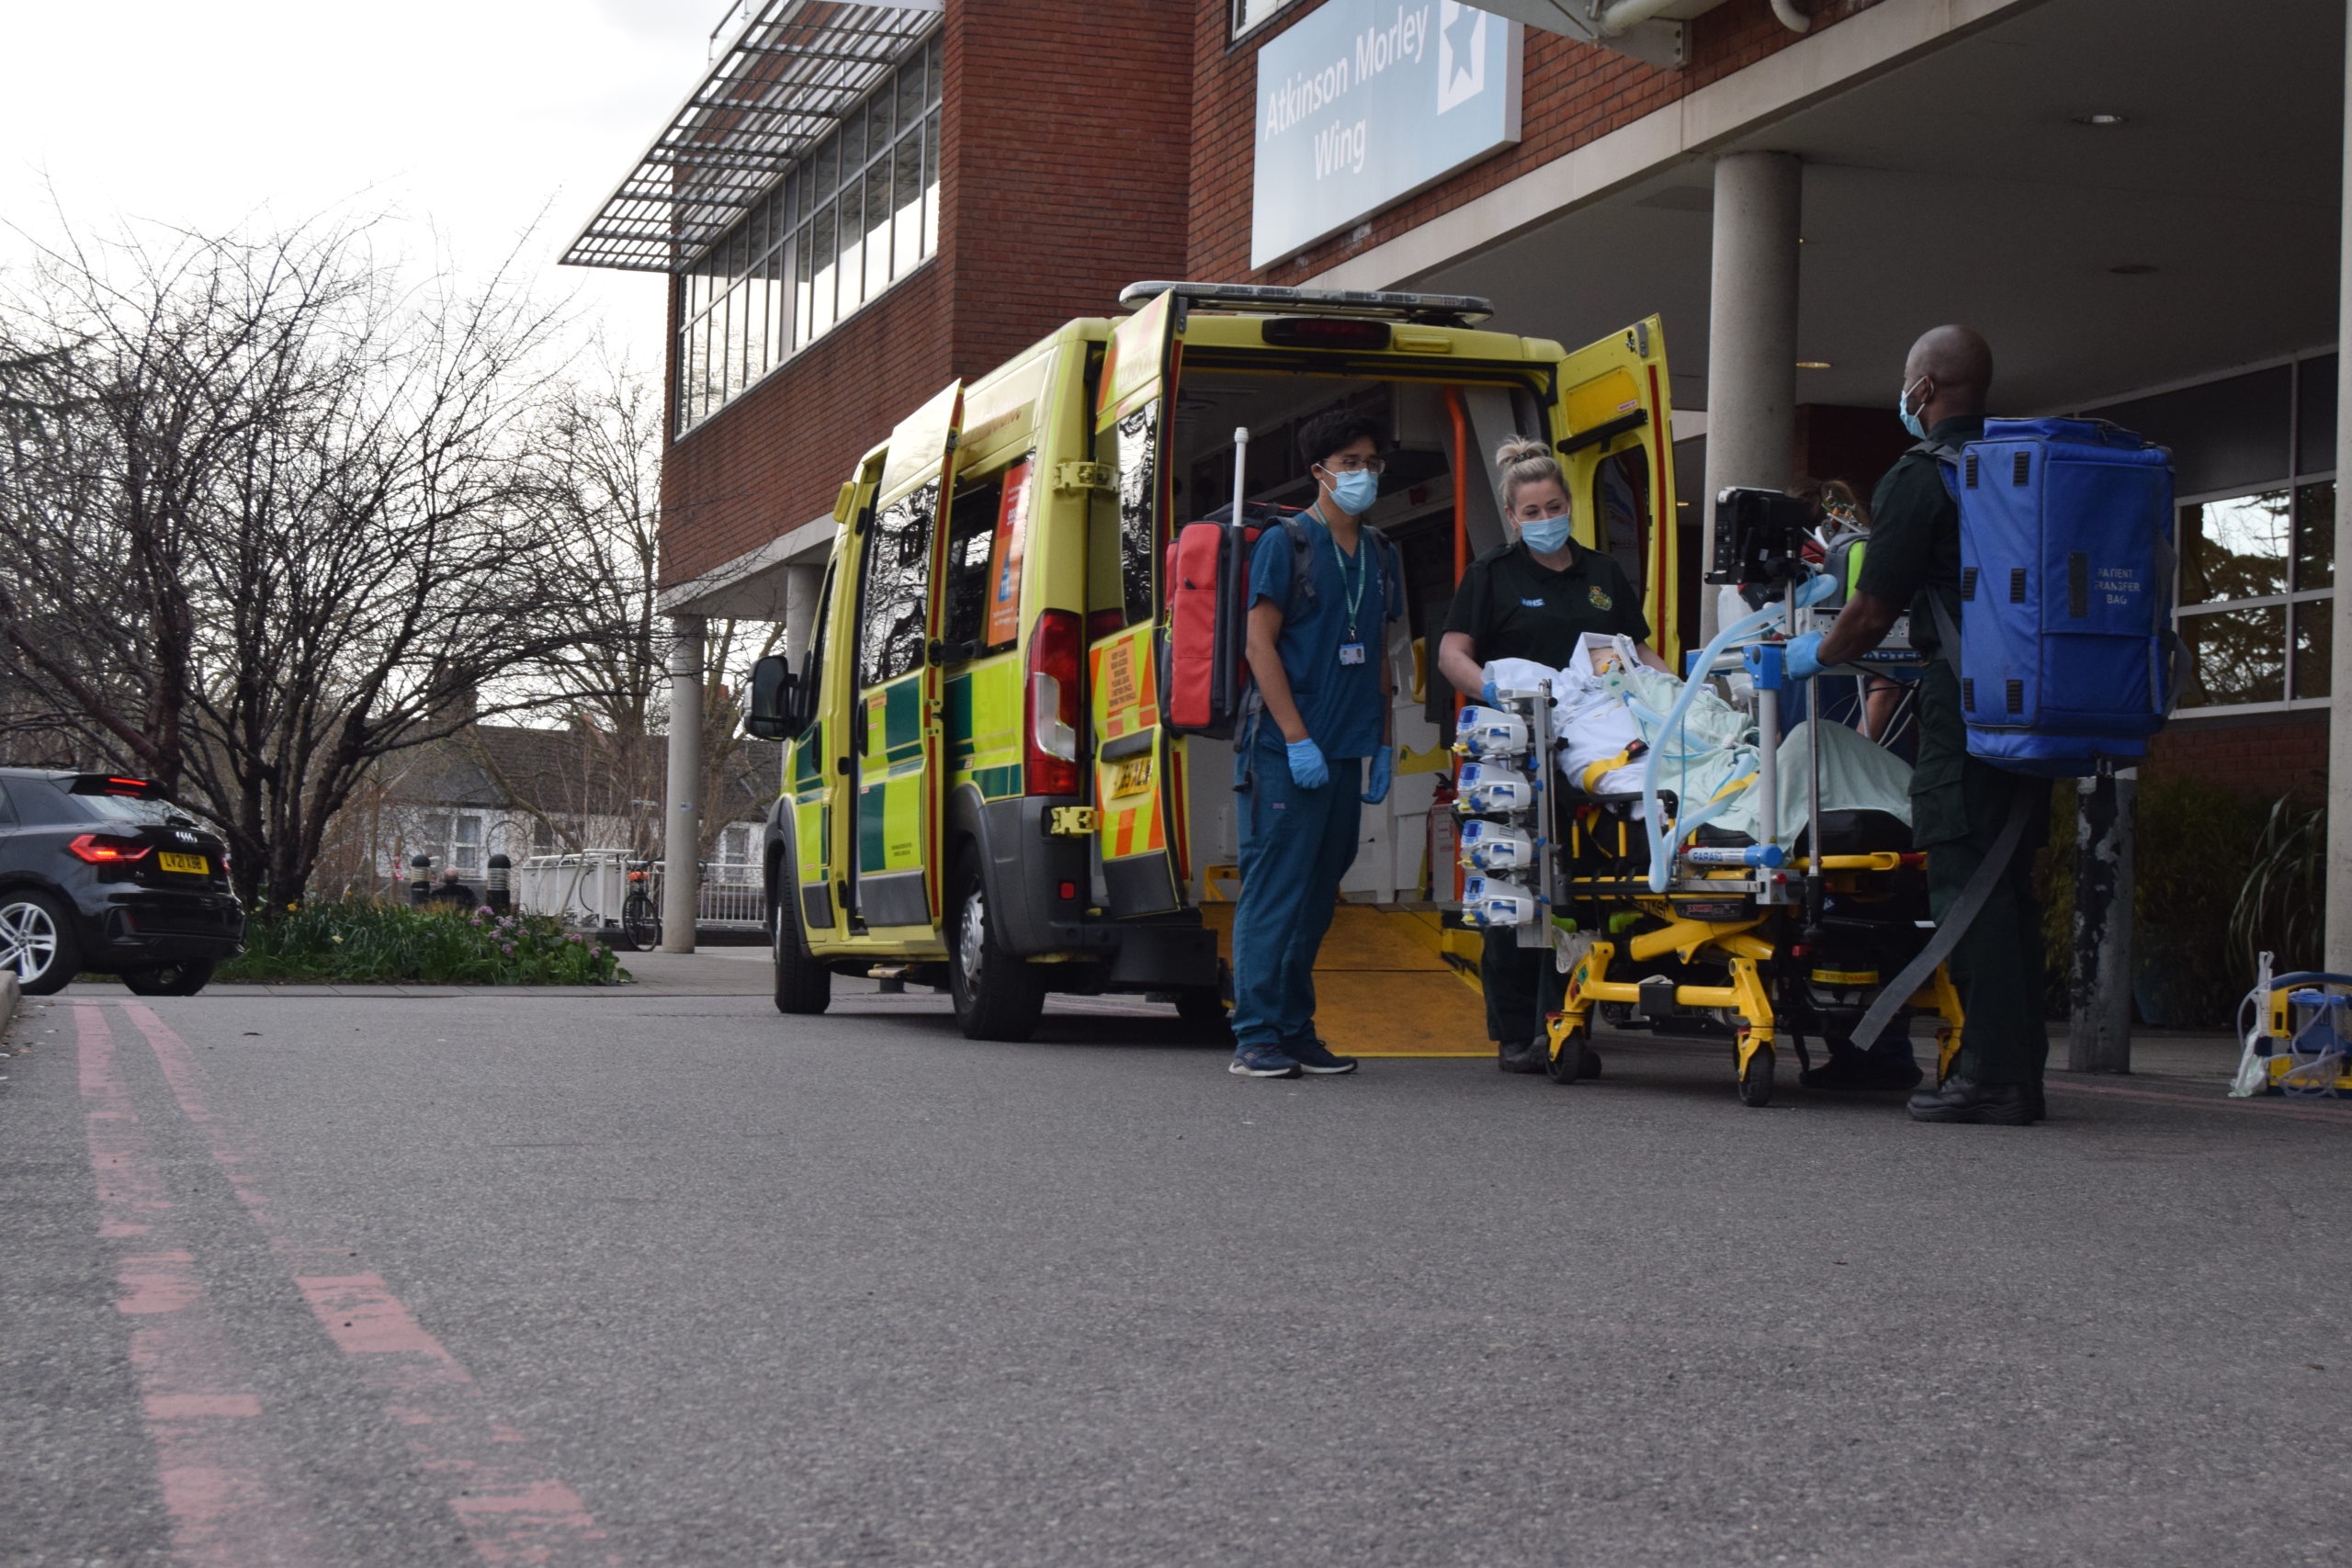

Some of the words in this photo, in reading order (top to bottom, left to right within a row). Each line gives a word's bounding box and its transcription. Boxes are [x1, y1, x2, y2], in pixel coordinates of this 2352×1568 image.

[1264, 57, 1348, 141] Atkinson
[1355, 6, 1429, 85] Morley
[1315, 118, 1366, 180] Wing
[2098, 568, 2133, 578] PATIENT
[2107, 593, 2127, 604] BAG
